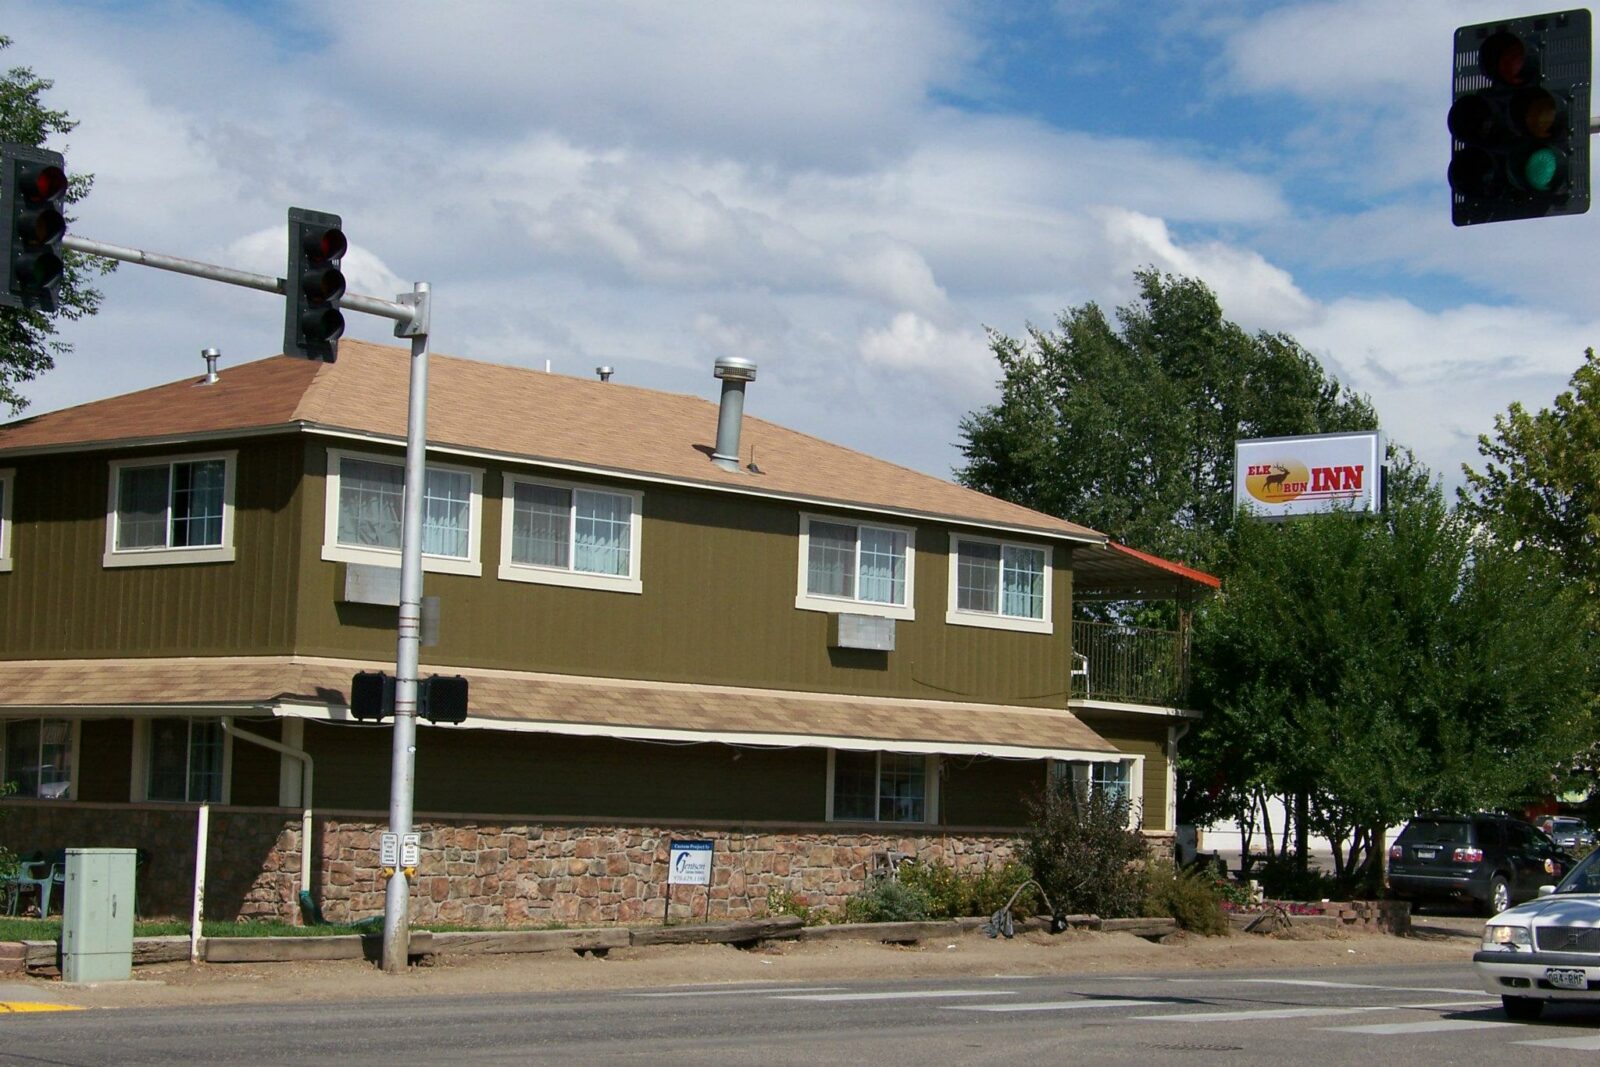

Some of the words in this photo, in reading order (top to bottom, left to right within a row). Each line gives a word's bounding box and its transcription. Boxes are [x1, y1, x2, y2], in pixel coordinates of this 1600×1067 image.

[1248, 464, 1272, 476] ELK
[1311, 465, 1364, 491] INN
[1283, 482, 1308, 493] RUN
